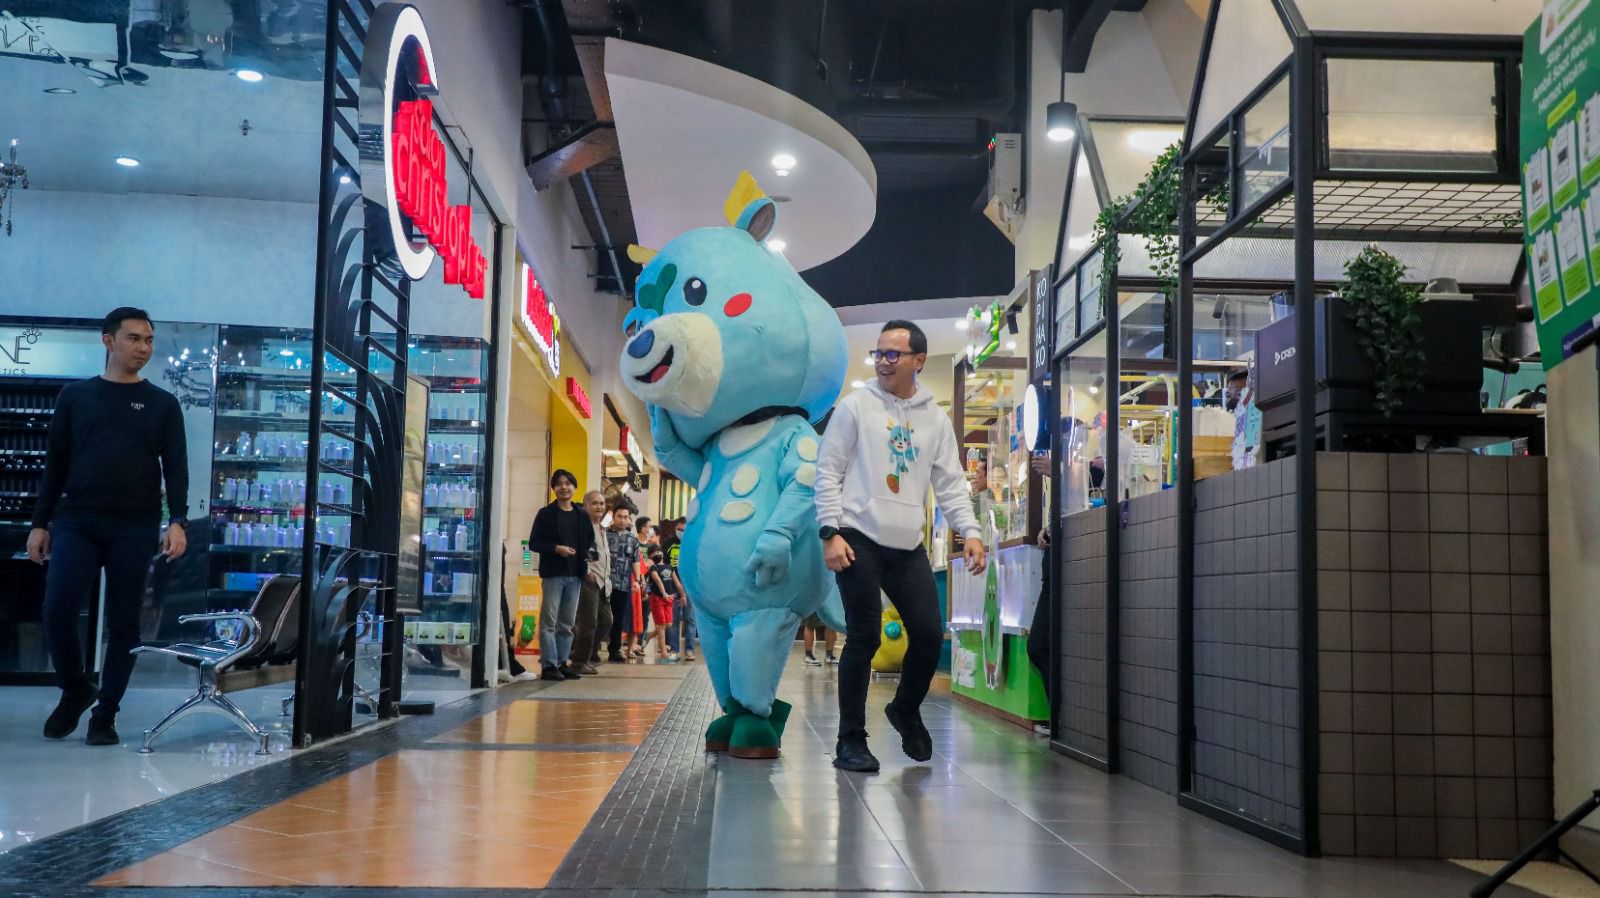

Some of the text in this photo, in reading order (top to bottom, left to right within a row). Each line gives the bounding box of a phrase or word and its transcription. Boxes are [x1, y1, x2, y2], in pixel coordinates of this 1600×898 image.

[411, 102, 447, 180] salon
[1036, 276, 1047, 302] KO
[1036, 299, 1045, 324] PI
[1035, 345, 1046, 369] KO
[0, 368, 26, 376] TICS
